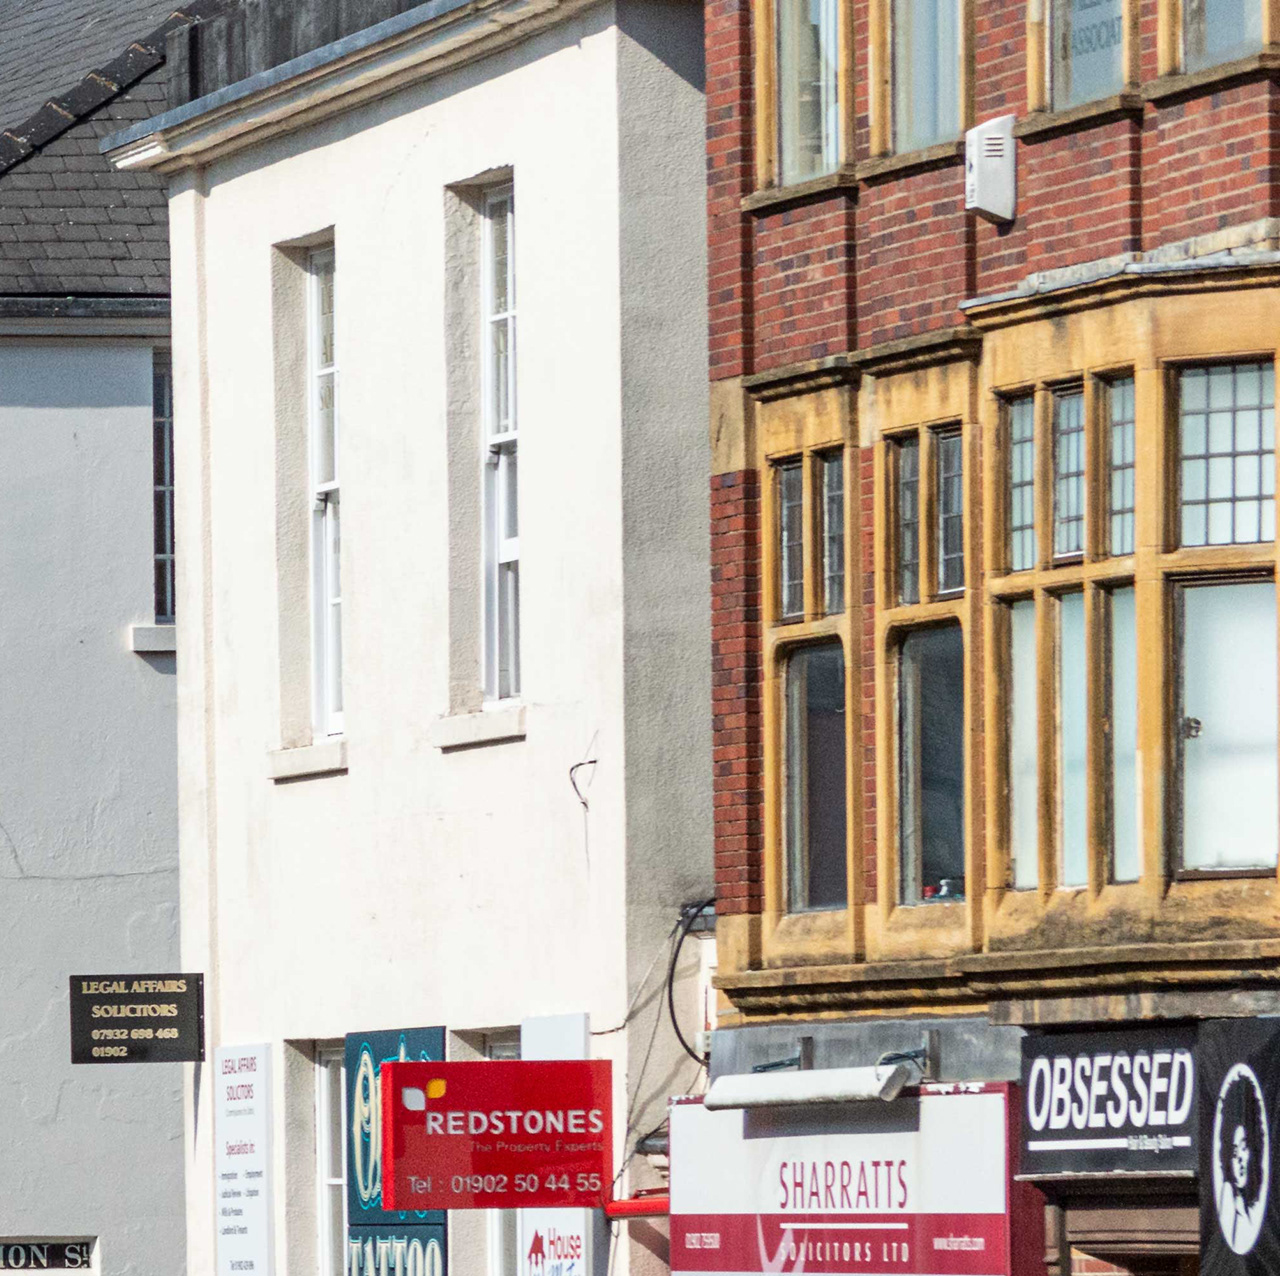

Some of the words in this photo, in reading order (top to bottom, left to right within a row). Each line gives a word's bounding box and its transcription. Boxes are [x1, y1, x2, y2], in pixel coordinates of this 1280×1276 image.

[82, 981, 128, 994] LEGAL
[131, 979, 187, 993] AFFAIRS
[91, 1004, 178, 1018] SOLICITORS
[1027, 1050, 1194, 1131] OBSESSED
[426, 1109, 604, 1135] REDSTONES
[451, 1174, 509, 1194] 01902
[514, 1174, 539, 1193] 50
[545, 1173, 570, 1192] 44
[576, 1173, 602, 1192] 55
[780, 1160, 908, 1209] SHARRATTS
[548, 1227, 582, 1260] House
[780, 1242, 872, 1262] SOLICITORS
[883, 1242, 910, 1262] LTD
